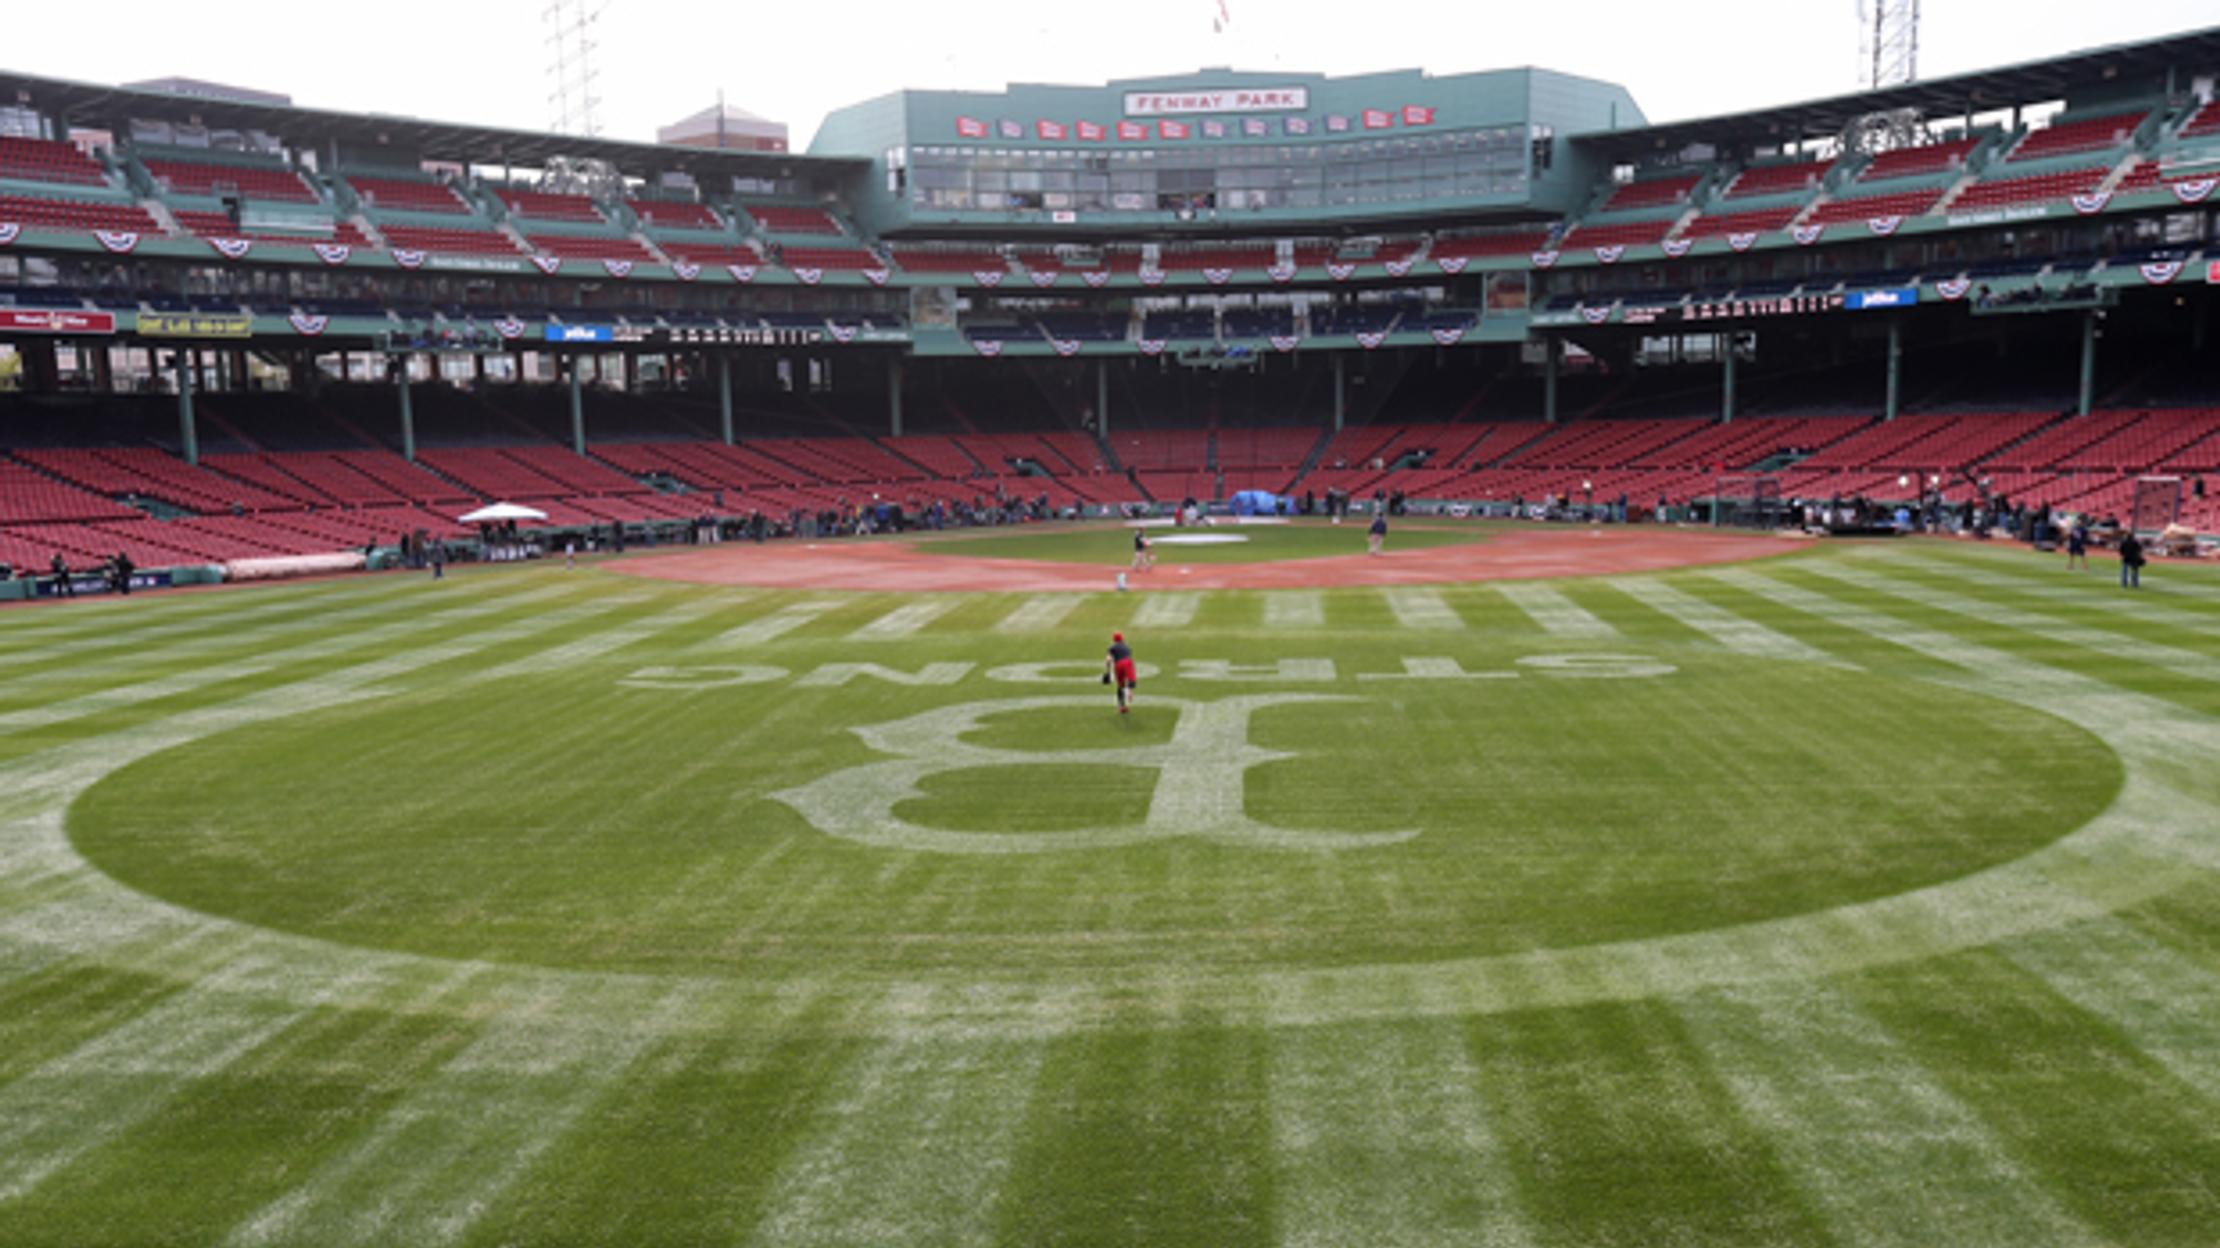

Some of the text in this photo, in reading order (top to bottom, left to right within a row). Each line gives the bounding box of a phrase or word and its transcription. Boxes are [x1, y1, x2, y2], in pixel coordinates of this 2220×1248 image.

[1137, 93, 1294, 111] FENWAY PARK
[616, 653, 1678, 689] STRONG
[767, 695, 1423, 854] B
